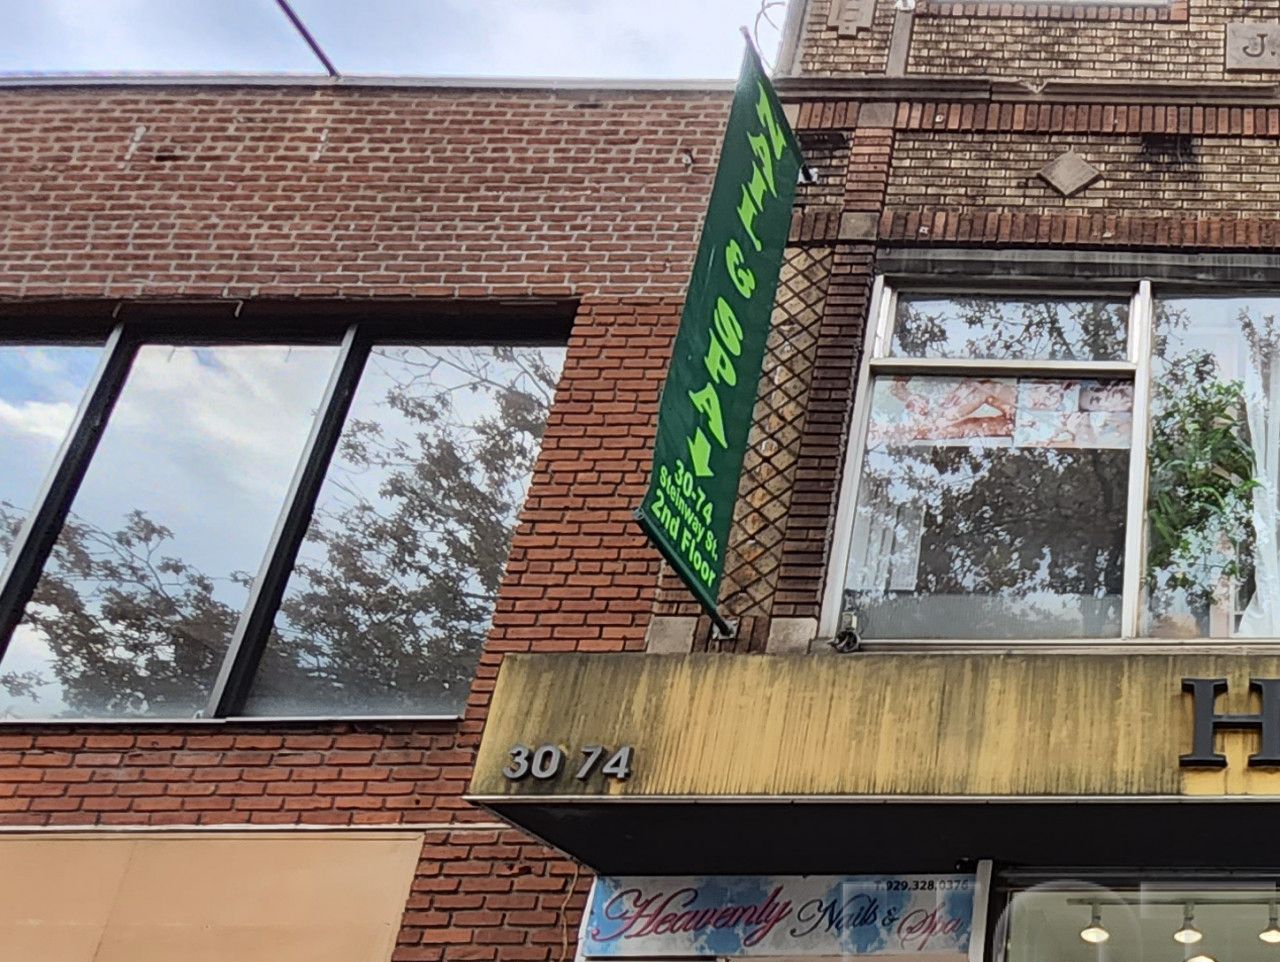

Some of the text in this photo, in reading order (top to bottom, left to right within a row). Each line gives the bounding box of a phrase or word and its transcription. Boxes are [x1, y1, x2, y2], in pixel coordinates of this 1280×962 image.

[688, 296, 744, 449] SPA
[659, 464, 705, 545] Steinway
[673, 458, 714, 528] 30-74
[651, 489, 717, 588] 2nd Floor
[502, 742, 635, 782] 30 74
[591, 884, 964, 952] Heavenly Nails & Spa
